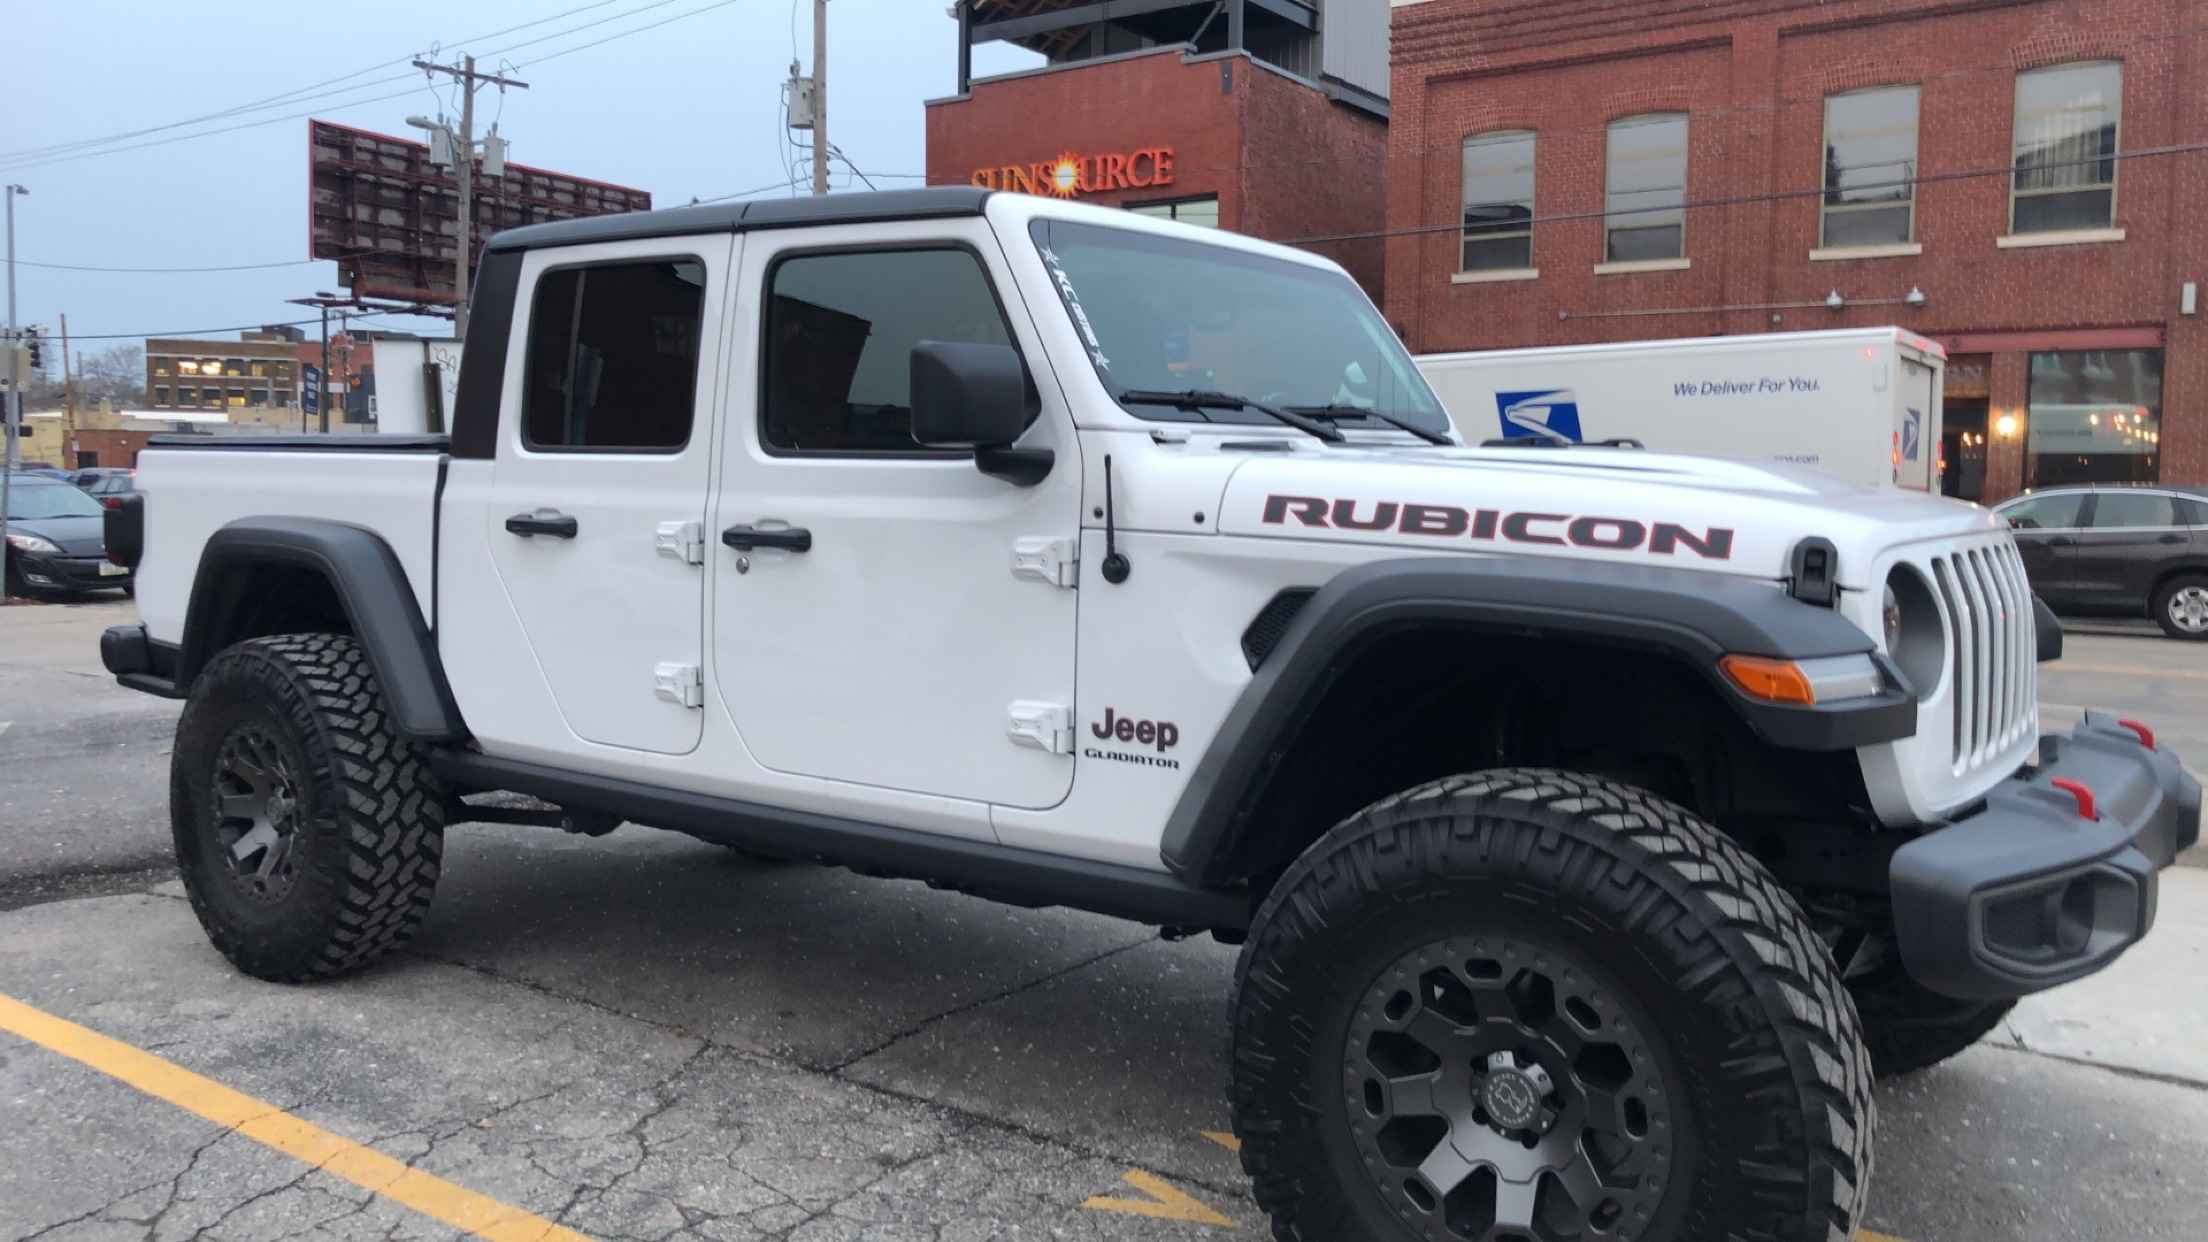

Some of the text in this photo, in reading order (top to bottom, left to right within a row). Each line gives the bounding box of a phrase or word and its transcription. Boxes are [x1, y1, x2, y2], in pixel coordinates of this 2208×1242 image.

[970, 147, 1175, 198] SUNSOURCE
[1673, 375, 1821, 397] We Deliver For You.
[1261, 493, 1735, 560] RUBICON
[1092, 706, 1179, 753] Jeep
[1084, 748, 1180, 770] GLADIATOR
